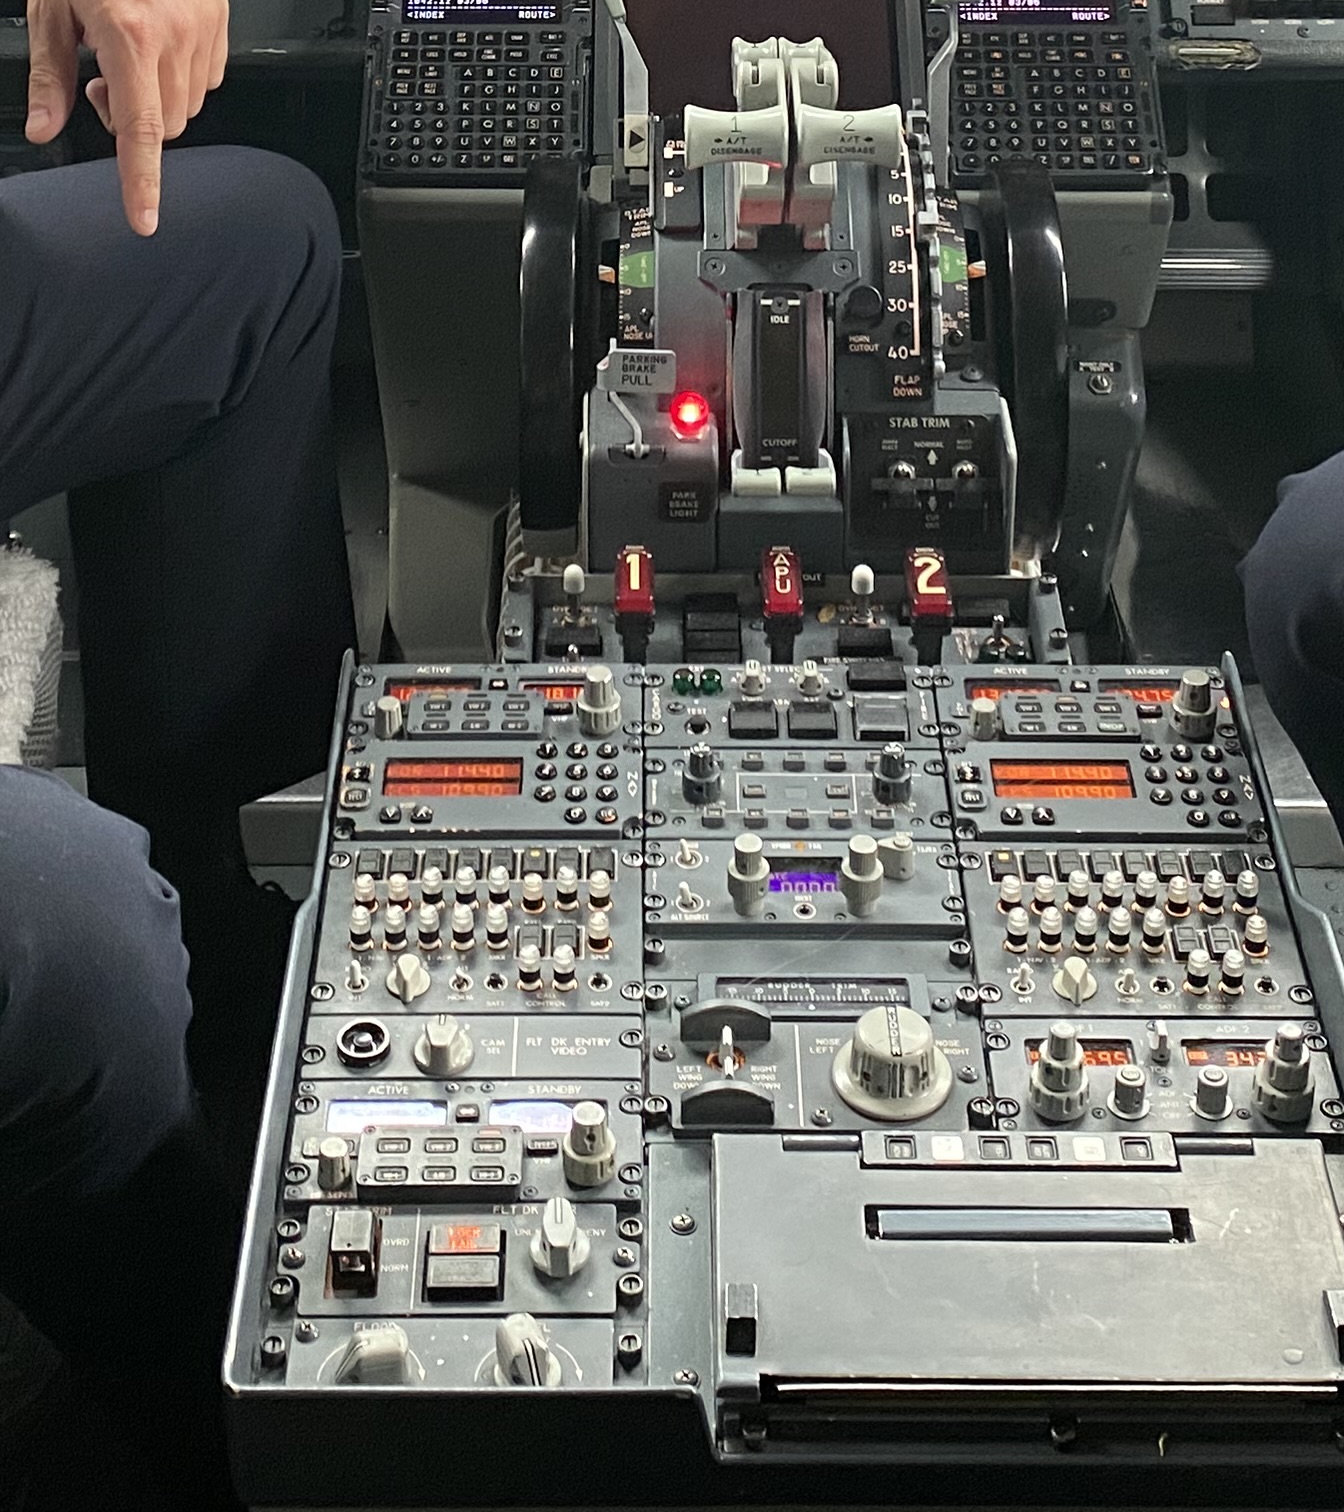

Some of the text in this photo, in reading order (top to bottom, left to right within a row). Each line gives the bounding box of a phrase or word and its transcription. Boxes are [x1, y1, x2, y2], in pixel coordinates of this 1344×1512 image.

[730, 116, 740, 133] 1
[844, 116, 855, 132] 2
[840, 135, 860, 144] A/T
[824, 146, 875, 155] DISENGAGE
[891, 170, 899, 180] 5
[889, 195, 902, 205] 10
[892, 226, 903, 237] 15
[889, 262, 906, 273] 25
[888, 300, 906, 311] 30
[770, 316, 790, 324] IDLE
[888, 347, 908, 359] 40
[622, 355, 667, 364] PARKING
[622, 365, 657, 374] BRAKE
[622, 375, 652, 386] PULL
[894, 375, 920, 385] FLAP
[893, 387, 922, 397] DOWN
[890, 418, 950, 428] STAB TRIM
[763, 439, 798, 447] CUTOFF
[626, 554, 640, 590] 1
[773, 553, 791, 594] APU
[915, 557, 946, 594] 2
[1125, 668, 1170, 676] STANDBY
[887, 1007, 901, 1056] RUDDER
[526, 1038, 610, 1047] FLT DK ENTRY
[551, 1047, 587, 1056] VIDEO
[368, 1085, 408, 1095] ACTIVE
[528, 1085, 581, 1095] STANDBY
[493, 1205, 539, 1215] FLT DK
[383, 1238, 409, 1246] OVRD
[380, 1264, 409, 1272] NORM
